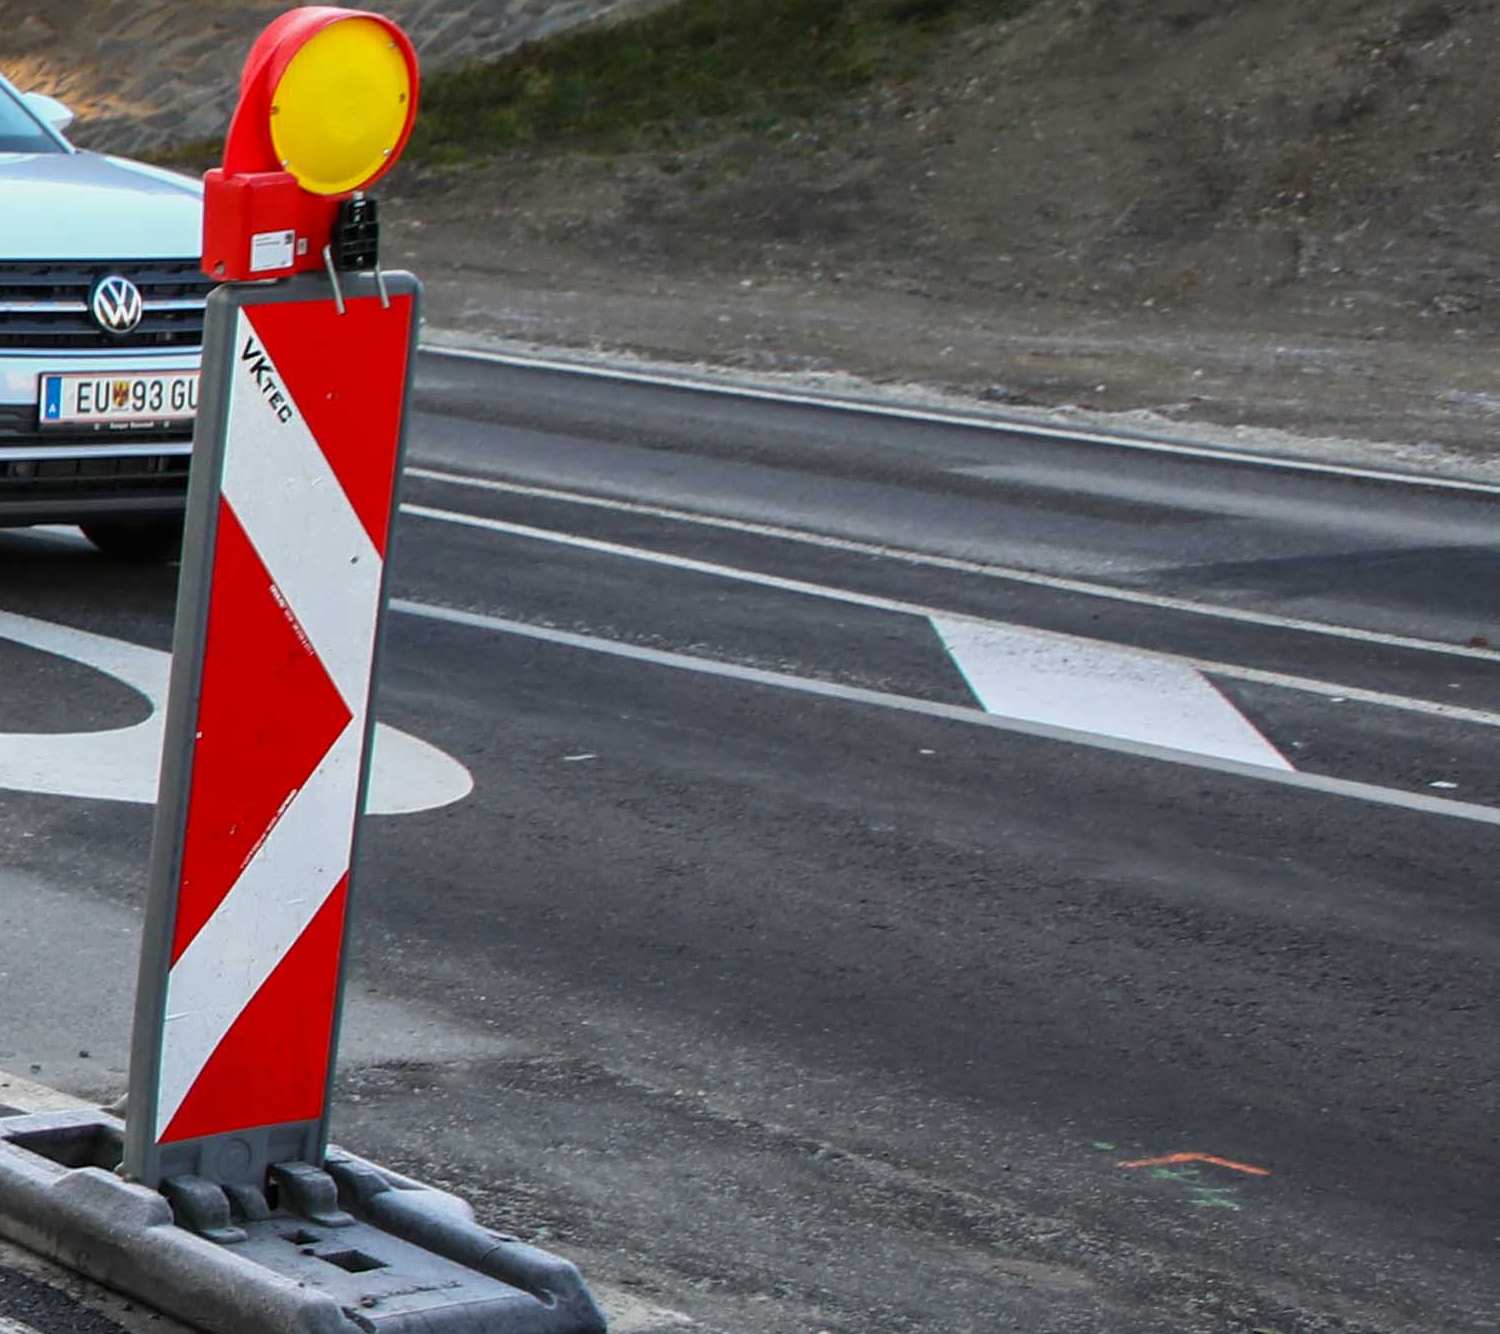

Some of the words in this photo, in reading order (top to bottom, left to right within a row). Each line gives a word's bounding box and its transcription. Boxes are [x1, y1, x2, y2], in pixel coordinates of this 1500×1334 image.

[77, 380, 110, 413] EU
[132, 380, 163, 411] 93
[241, 335, 293, 424] VKTEC
